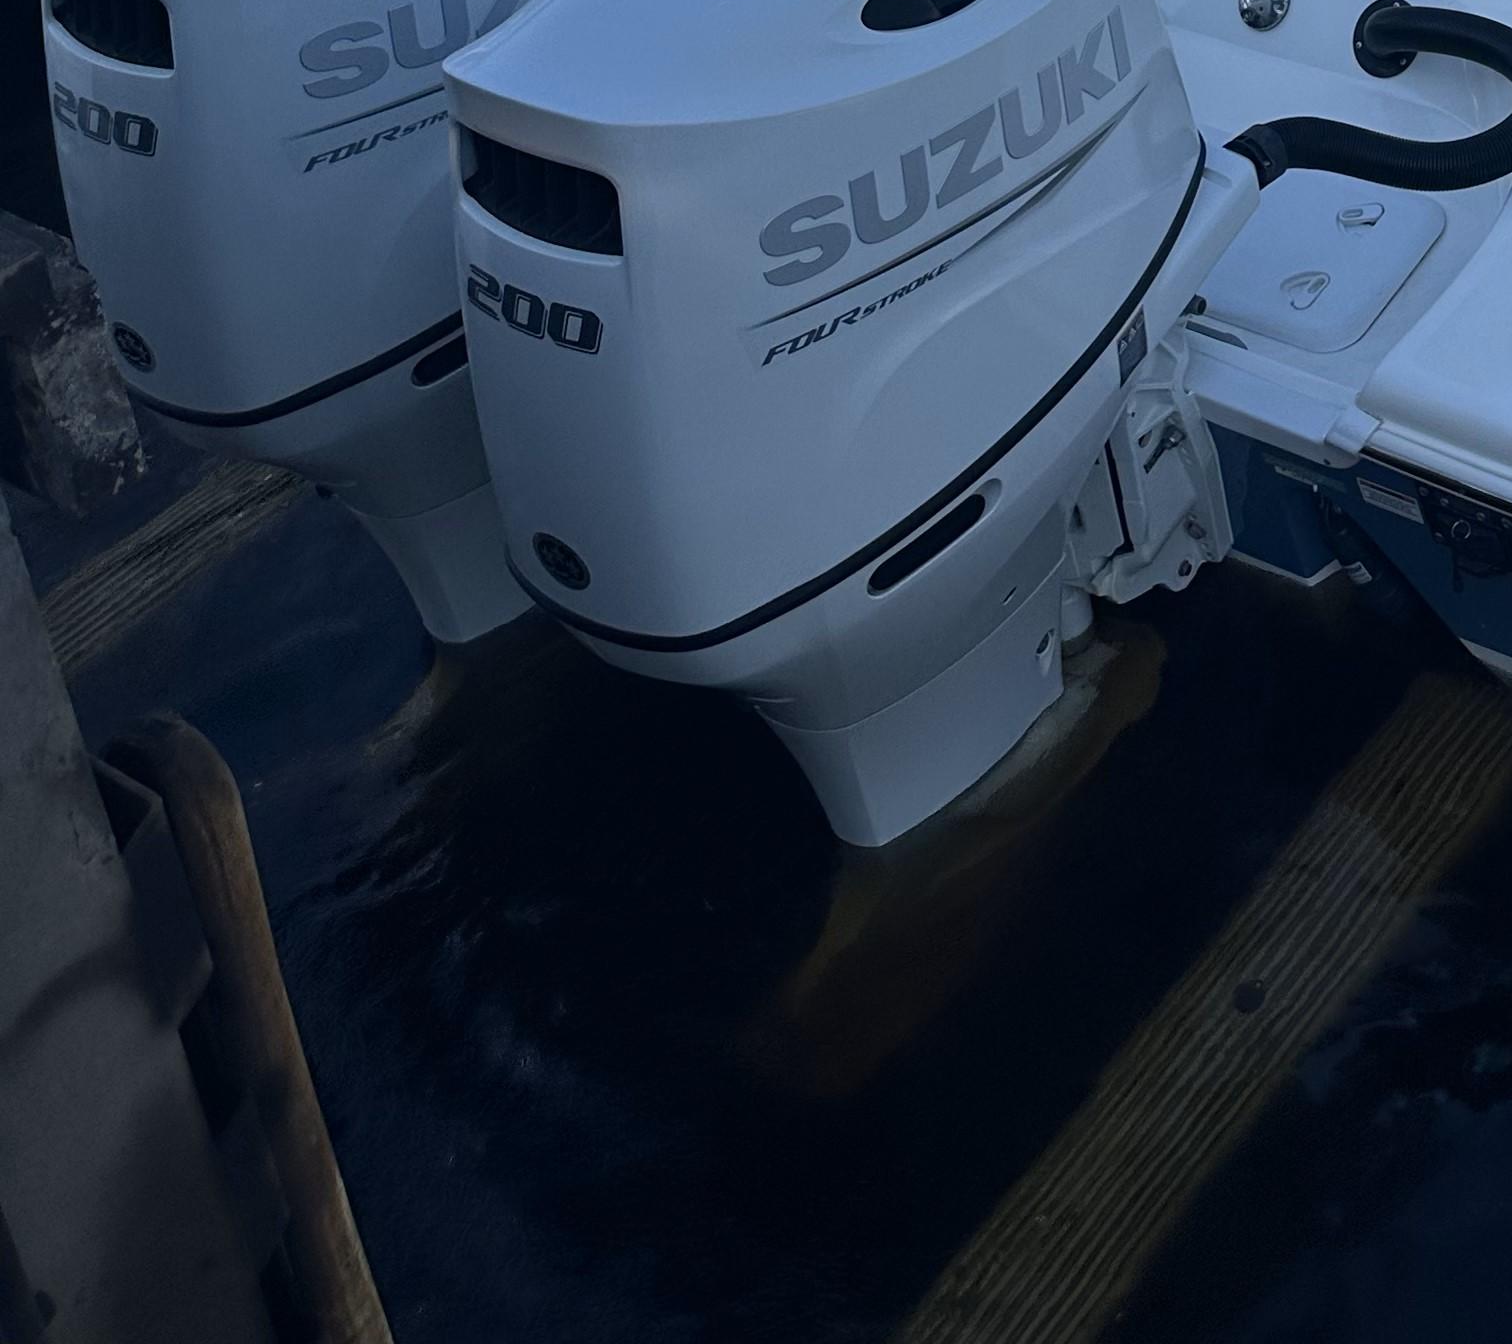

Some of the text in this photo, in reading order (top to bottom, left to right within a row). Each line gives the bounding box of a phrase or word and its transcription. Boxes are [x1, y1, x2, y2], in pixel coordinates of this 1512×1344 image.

[53, 81, 159, 157] 200
[758, 4, 1132, 287] SUZUKI
[467, 263, 604, 355] 200
